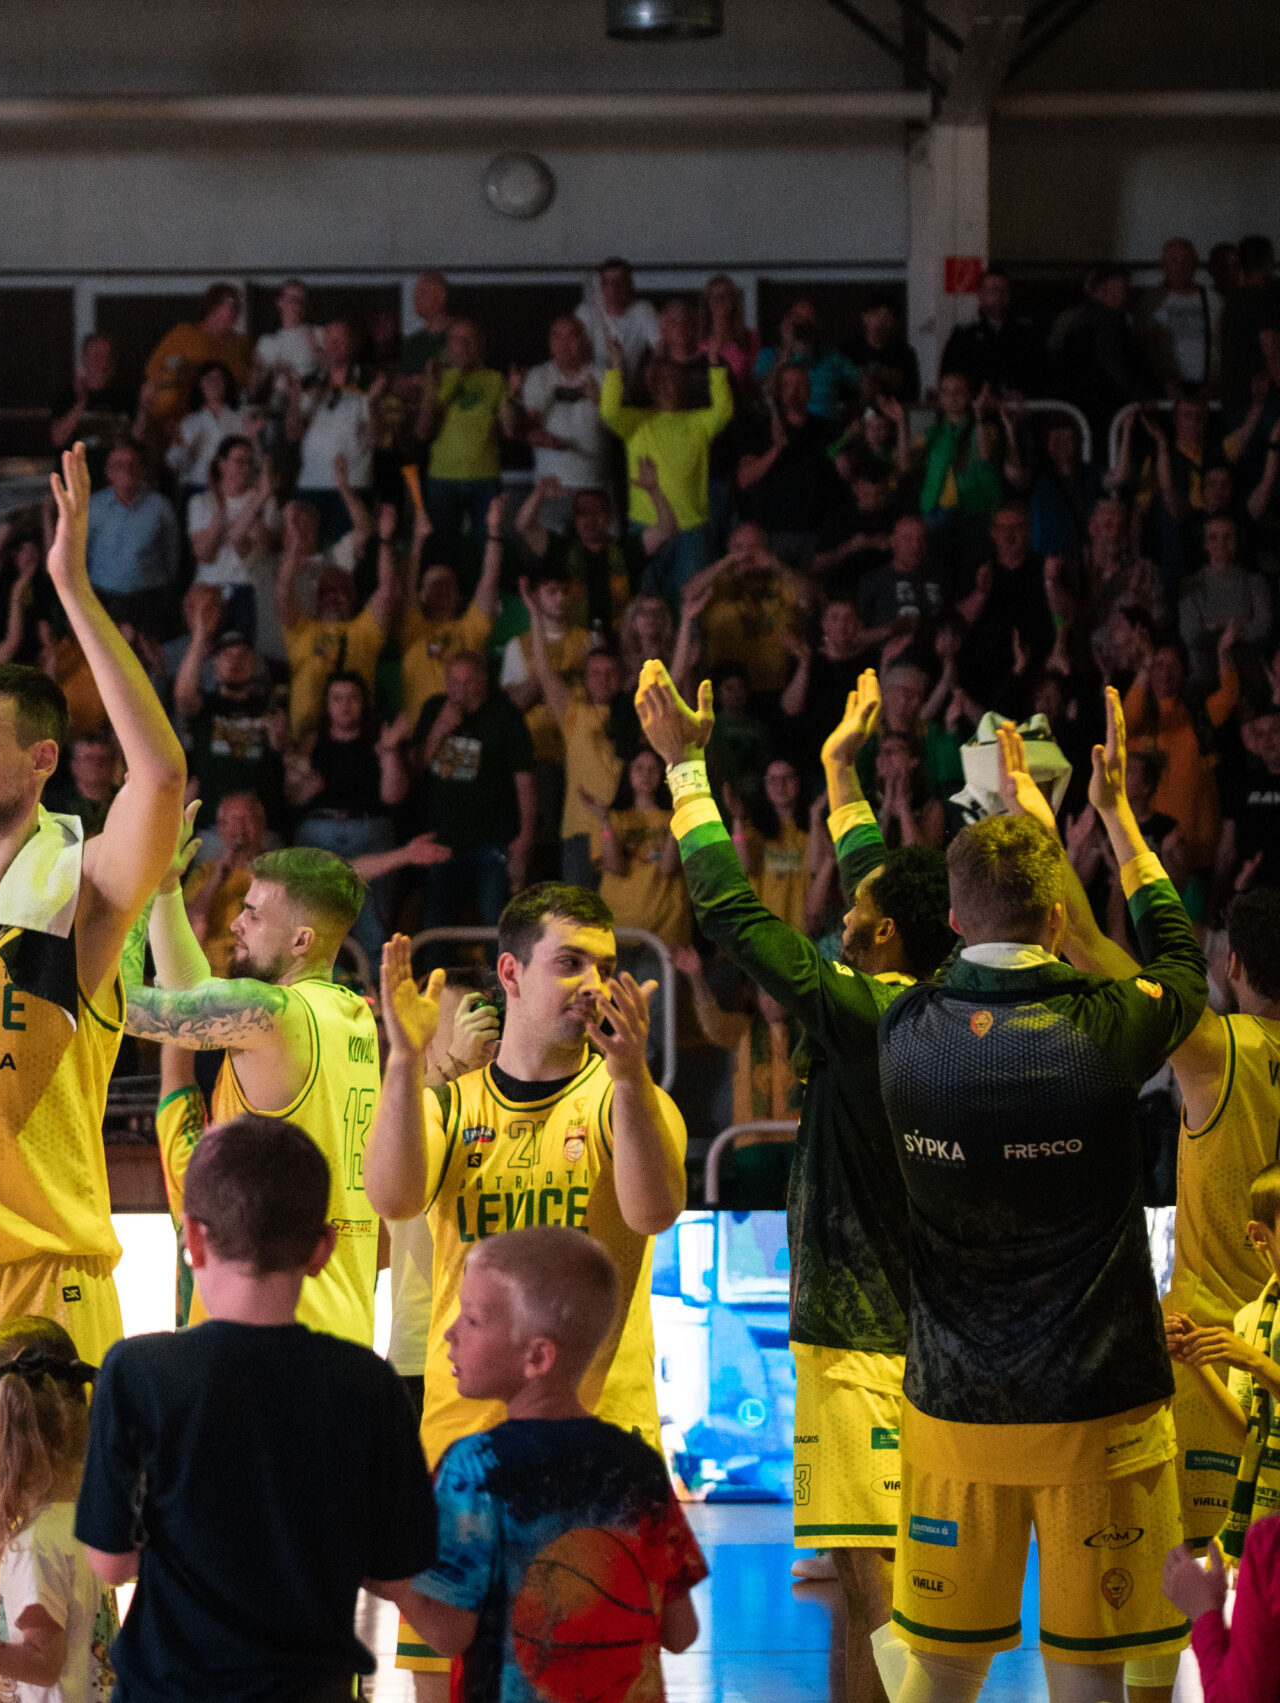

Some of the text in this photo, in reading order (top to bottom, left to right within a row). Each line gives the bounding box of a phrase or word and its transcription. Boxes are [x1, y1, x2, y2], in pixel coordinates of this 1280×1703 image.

[507, 1120, 546, 1168] 21
[904, 1129, 966, 1161] SÝPKA
[1003, 1138, 1083, 1160] FRESCO
[457, 1186, 590, 1243] LEVICE
[794, 1464, 812, 1506] 3
[883, 1481, 901, 1490] VIA
[1193, 1497, 1229, 1508] VIALLE
[912, 1576, 944, 1592] VIALLE
